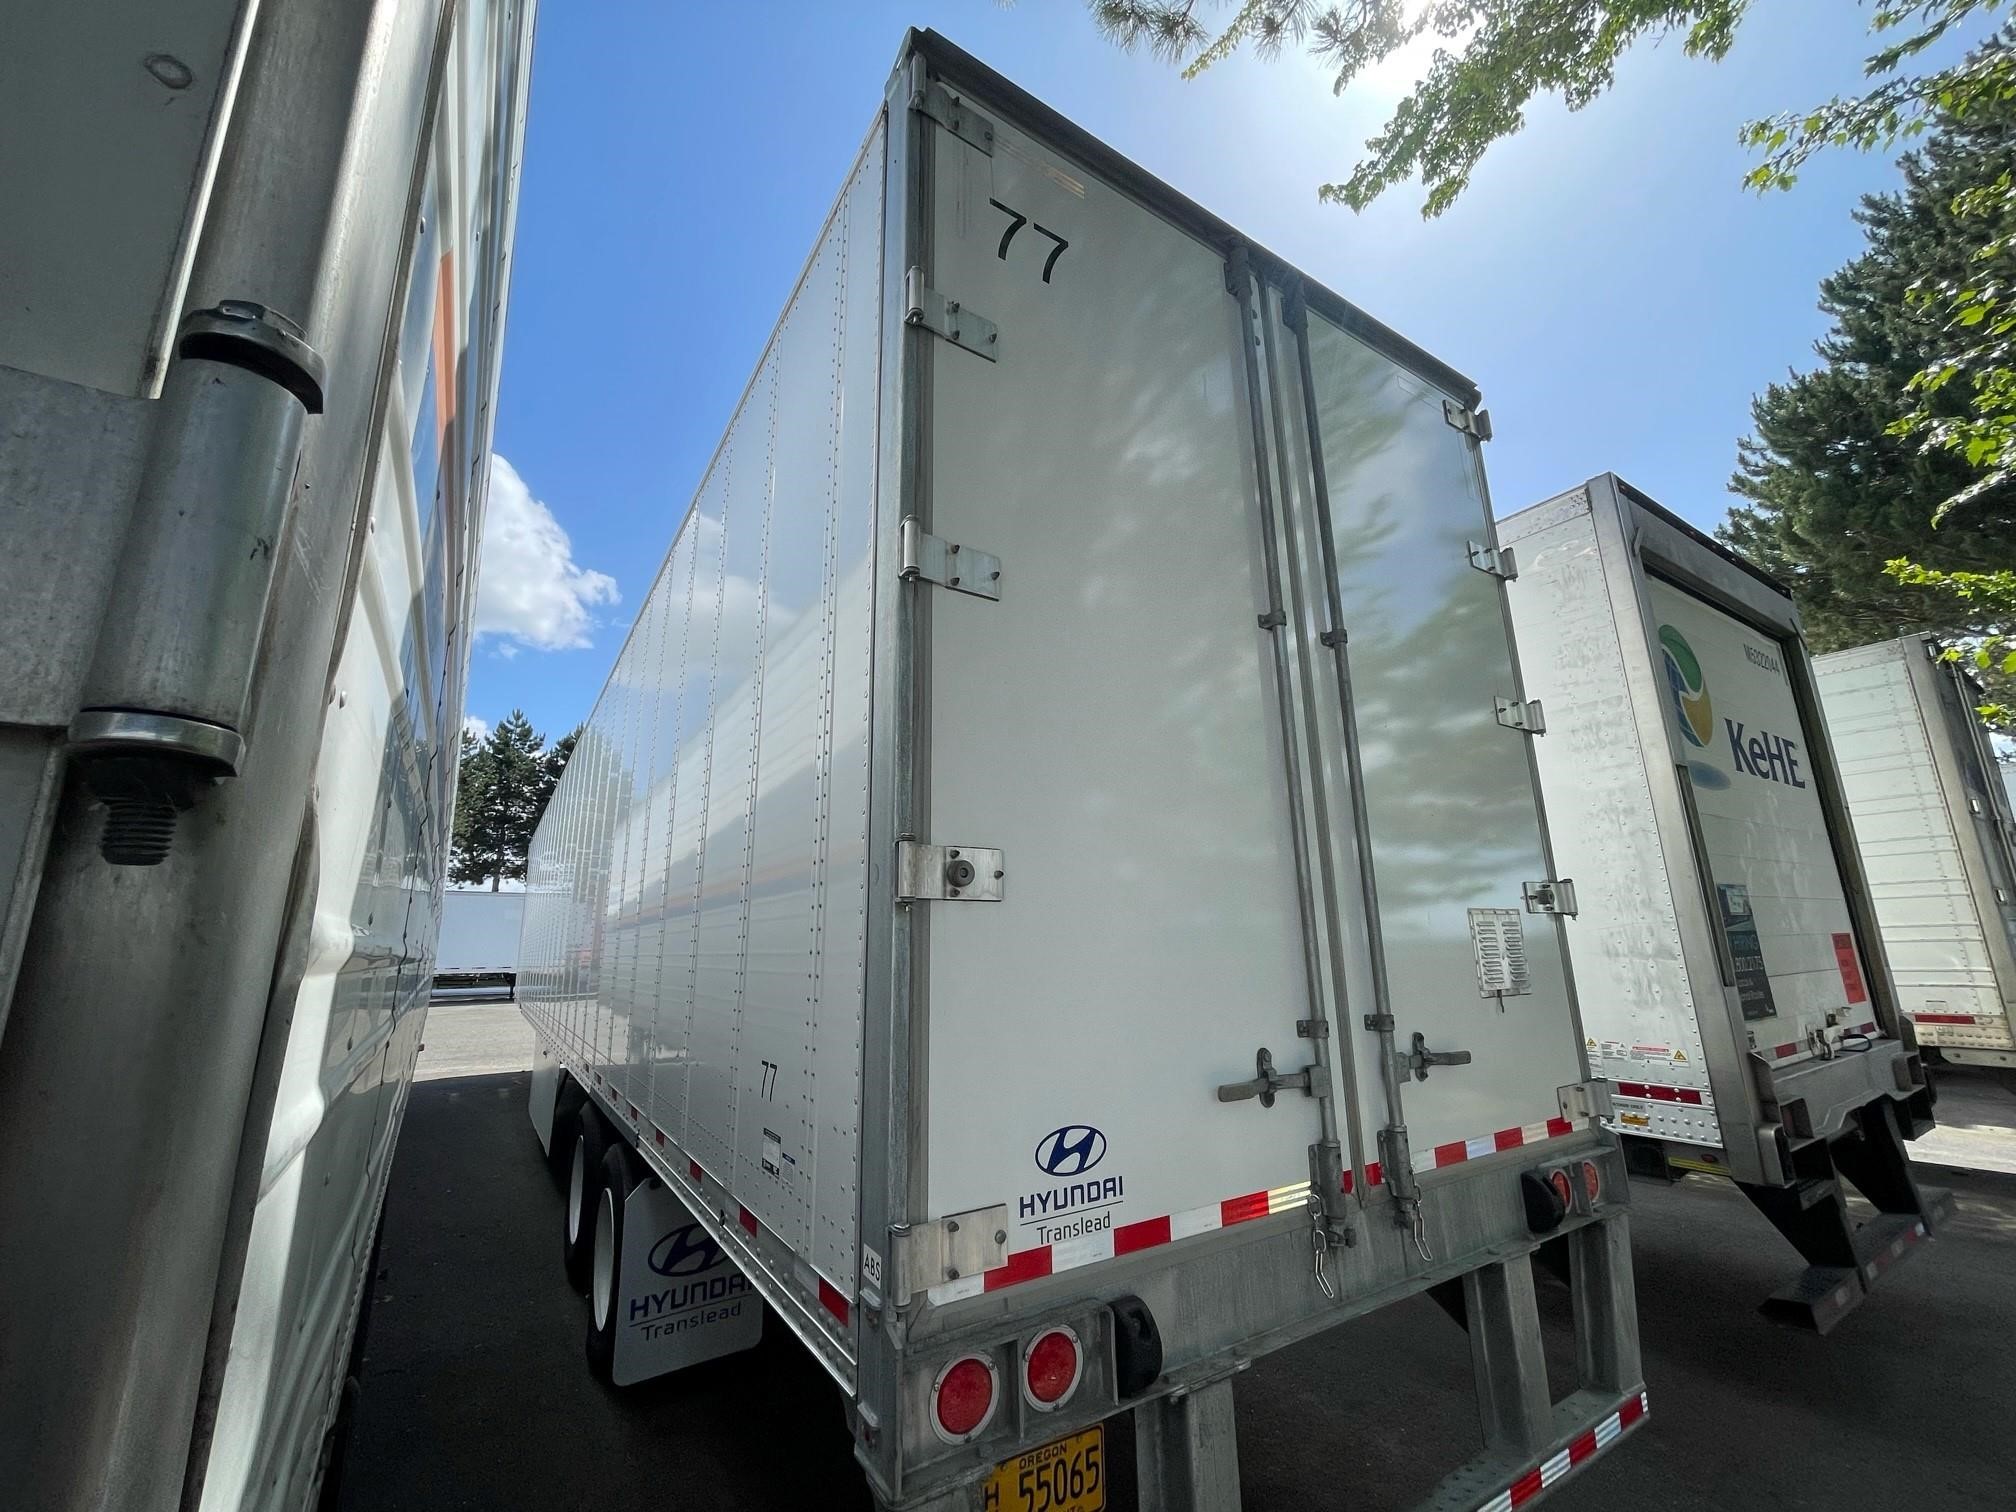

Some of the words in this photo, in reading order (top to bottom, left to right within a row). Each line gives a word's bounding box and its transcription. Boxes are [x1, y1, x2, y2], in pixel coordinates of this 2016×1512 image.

[989, 197, 1069, 284] 77
[1723, 717, 1806, 789] KeHE
[761, 1060, 778, 1102] 77
[1020, 1175, 1123, 1219] HYUNDAI
[1036, 1210, 1111, 1245] Translead
[863, 1253, 881, 1281] ABS
[640, 1301, 742, 1342] Translead
[1019, 1441, 1068, 1470] OREGON
[1018, 1445, 1100, 1512] 55065
